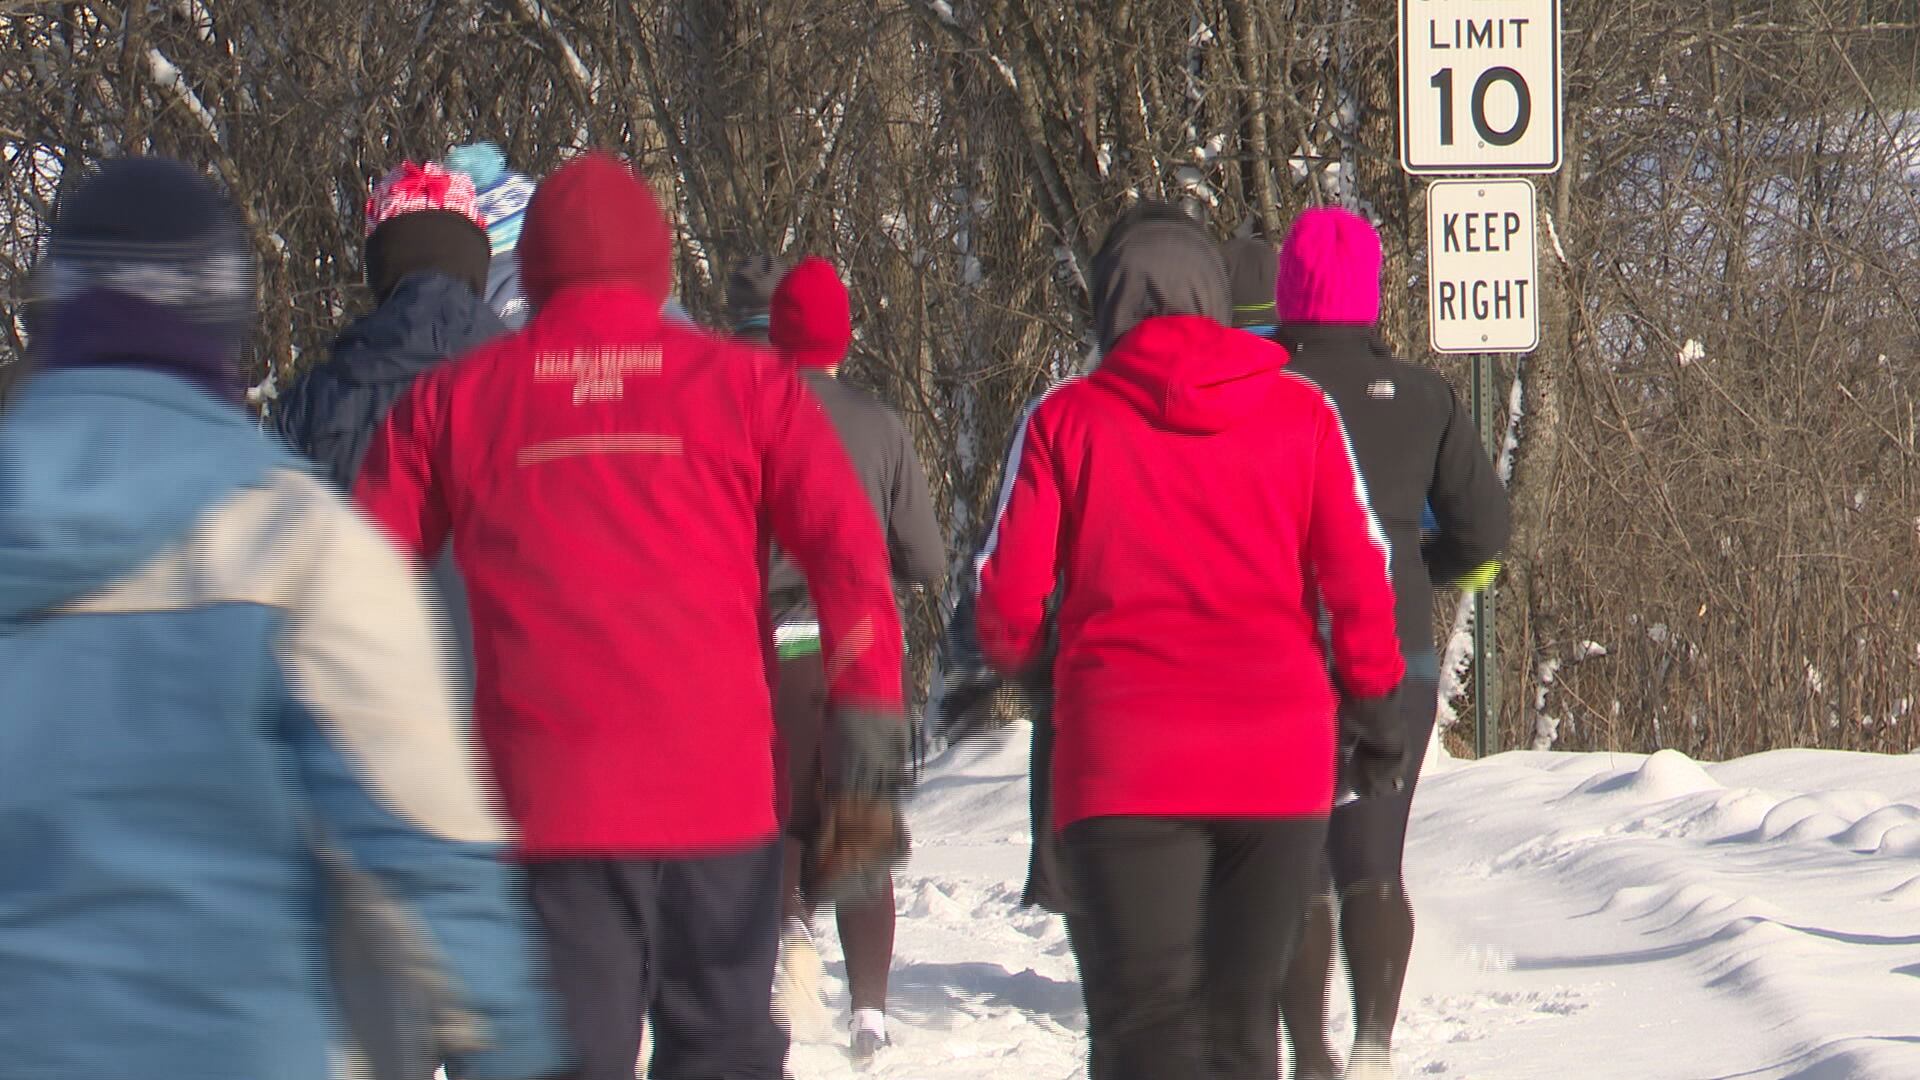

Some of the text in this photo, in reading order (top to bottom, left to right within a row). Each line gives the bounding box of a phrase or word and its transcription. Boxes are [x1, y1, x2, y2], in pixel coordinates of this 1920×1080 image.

[1430, 19, 1529, 49] LIMIT
[1430, 66, 1531, 146] 10
[1443, 212, 1520, 252] KEEP
[1439, 280, 1528, 320] RIGHT
